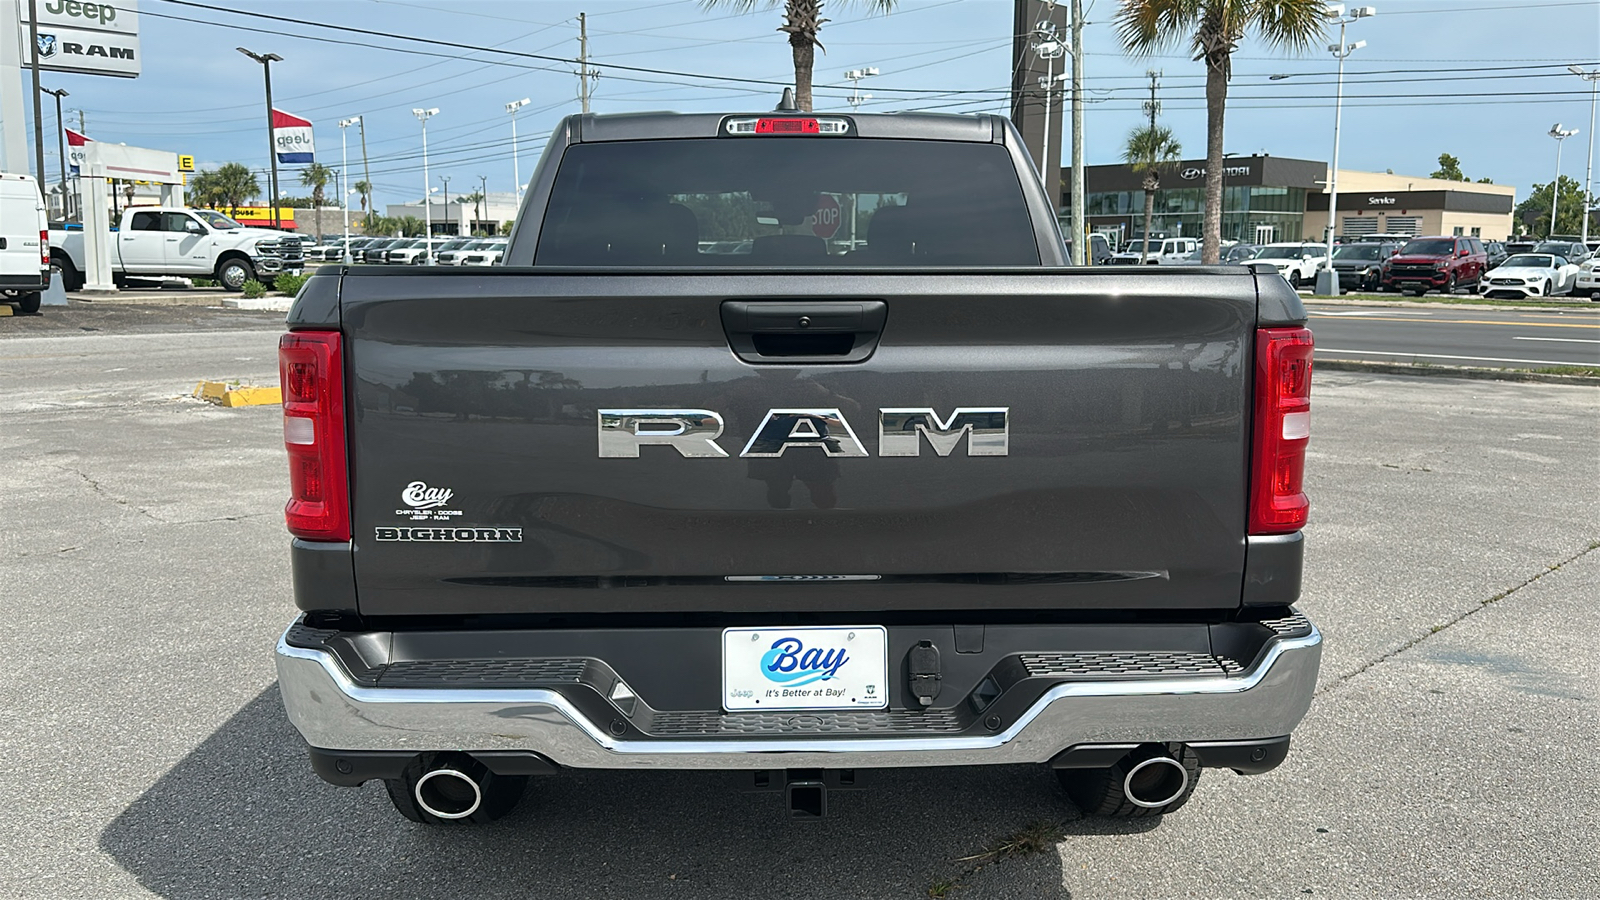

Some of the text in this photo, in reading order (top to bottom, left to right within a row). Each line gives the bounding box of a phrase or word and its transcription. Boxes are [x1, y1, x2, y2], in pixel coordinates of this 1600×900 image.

[45, 0, 116, 25] Jeep
[63, 42, 135, 60] RAM
[1368, 196, 1396, 205] Service
[597, 407, 1010, 458] RAM
[406, 480, 454, 507] Bay
[375, 526, 523, 543] BIGHORN
[766, 636, 850, 682] Bay
[730, 688, 754, 698] Jeep
[765, 688, 847, 698] It's Better at Bay!
